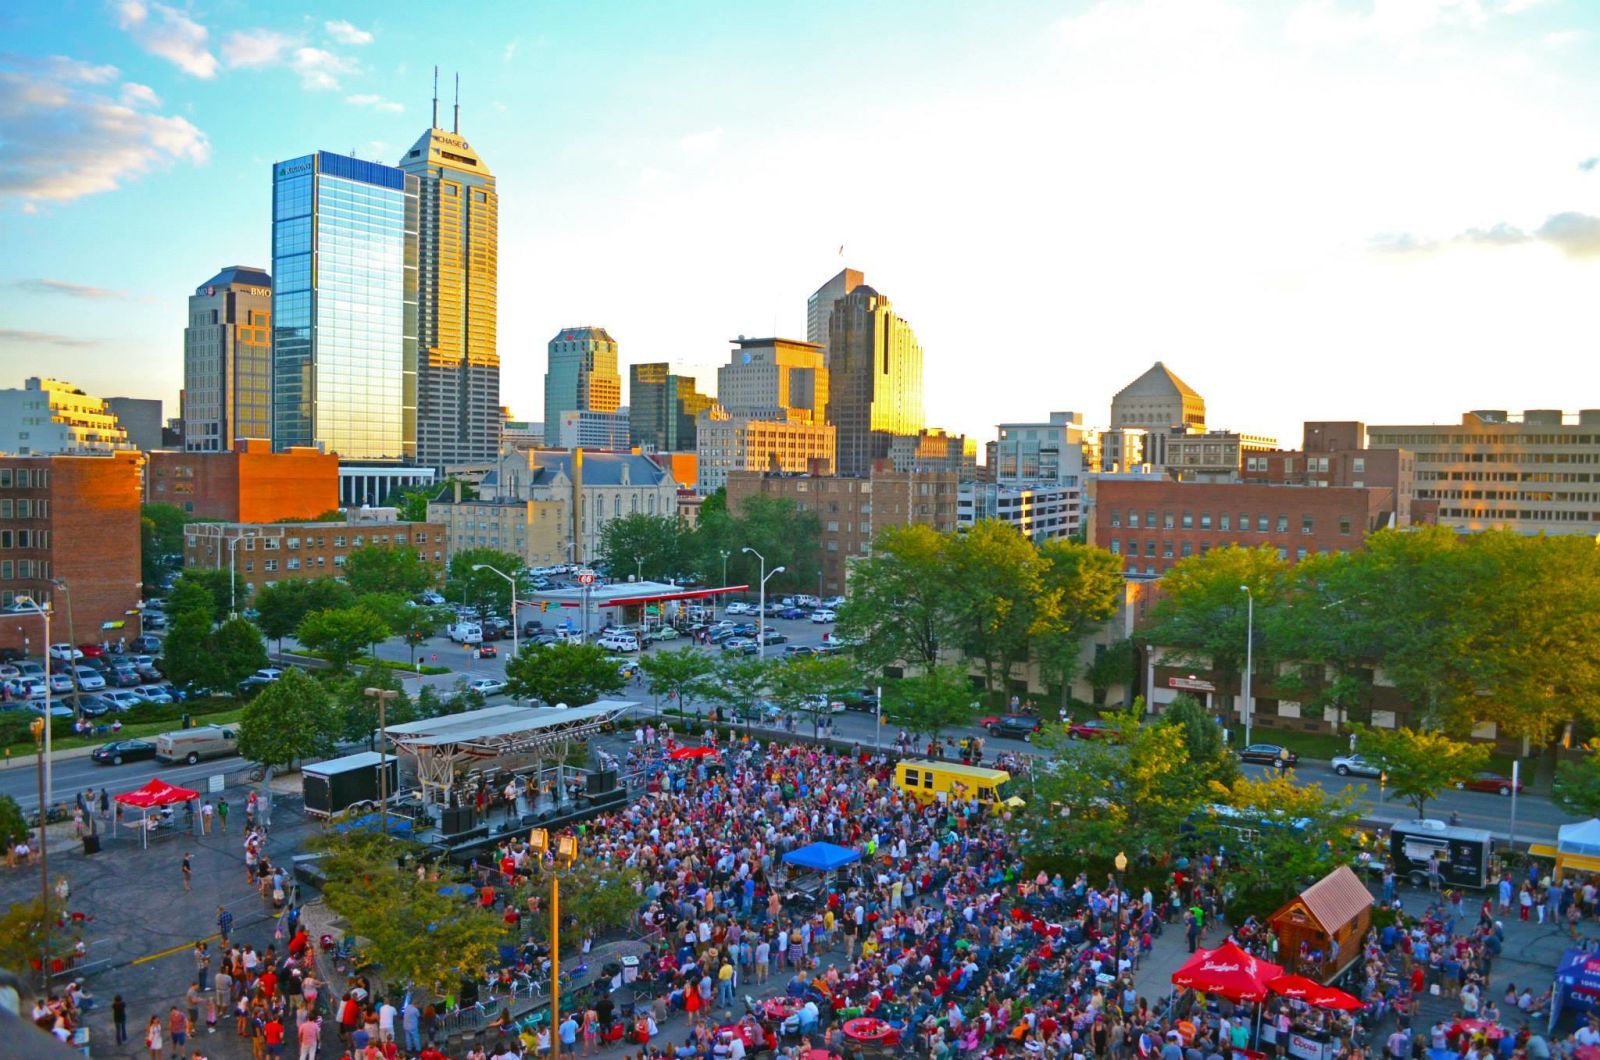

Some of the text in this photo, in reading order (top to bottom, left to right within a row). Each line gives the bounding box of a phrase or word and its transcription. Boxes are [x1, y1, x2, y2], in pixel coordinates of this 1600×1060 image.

[439, 136, 461, 147] CHASE
[251, 287, 271, 297] BMO
[582, 575, 592, 583] 66
